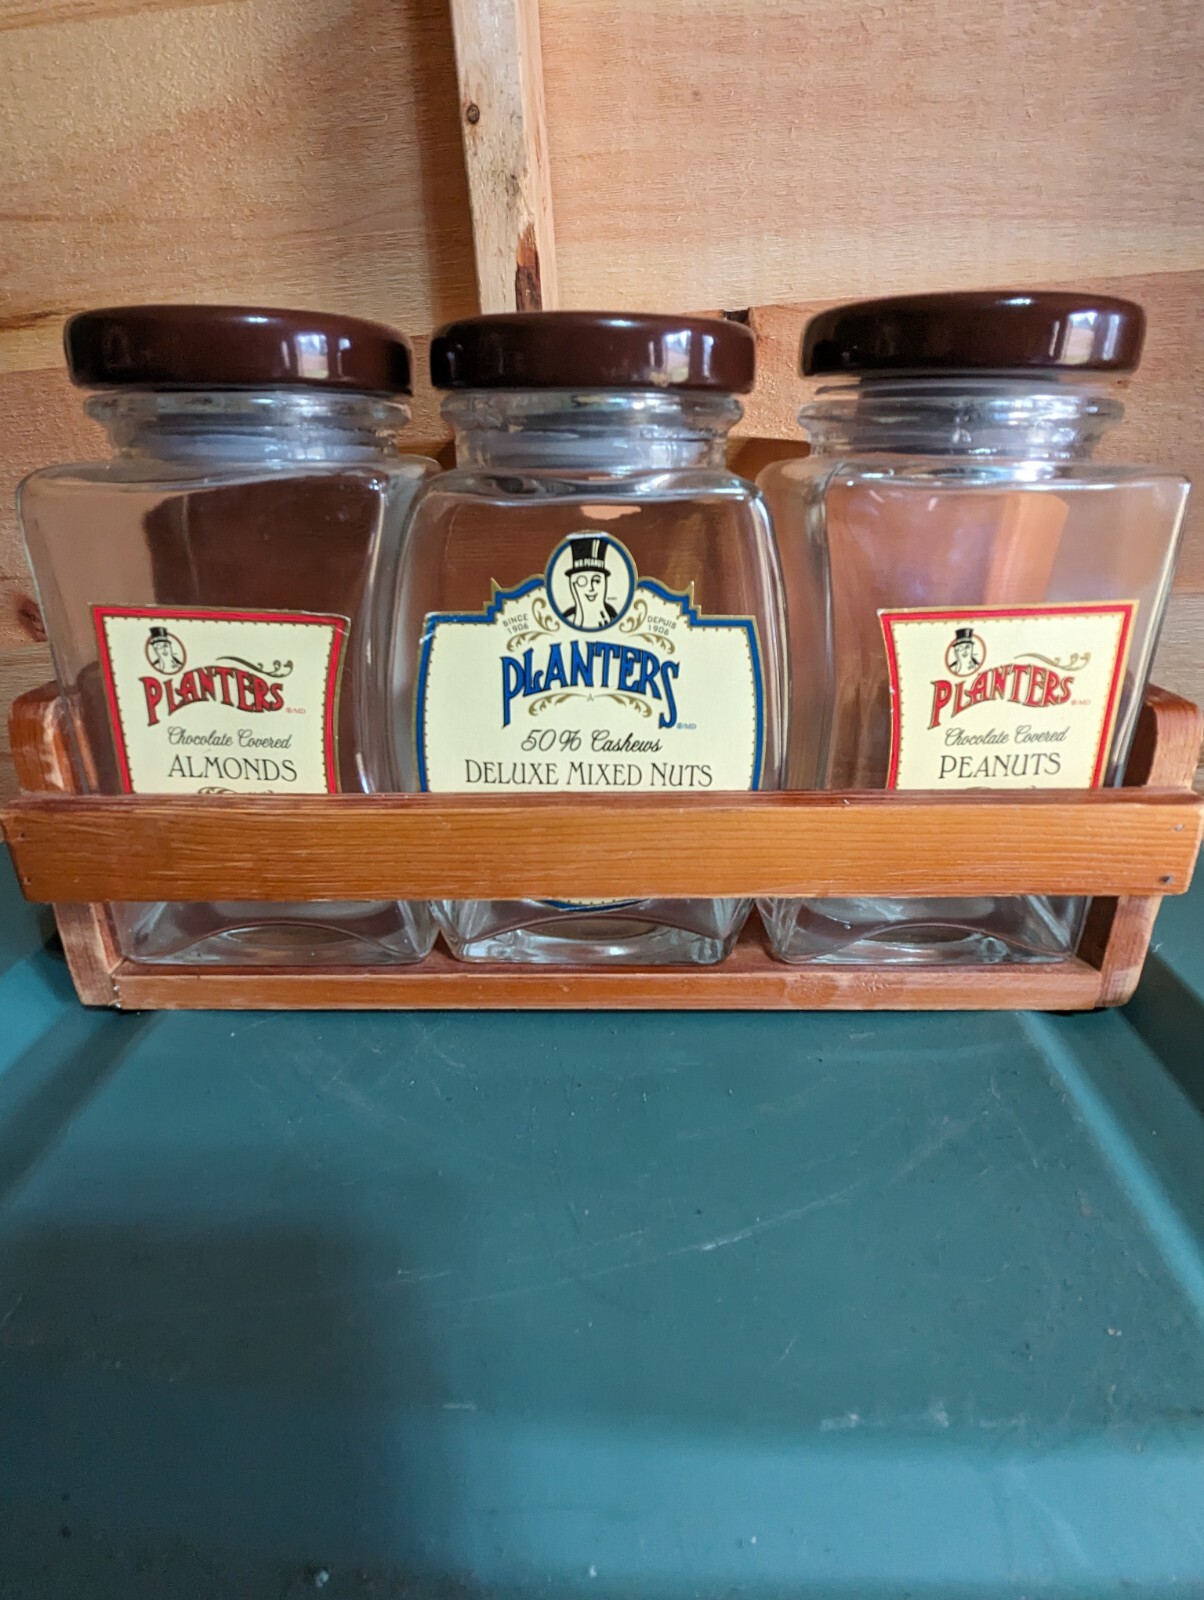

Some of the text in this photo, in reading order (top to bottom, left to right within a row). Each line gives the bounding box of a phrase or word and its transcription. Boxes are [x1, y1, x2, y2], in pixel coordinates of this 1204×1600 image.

[502, 613, 529, 627] SINCE
[507, 622, 530, 635] 1906
[647, 615, 677, 630] DEPUIS
[648, 624, 670, 636] 1906
[138, 665, 285, 727] PLANTERS
[500, 640, 680, 729] PLANTERS
[927, 663, 1075, 730] PLANTERS
[167, 726, 293, 749] Chocolate Covered
[521, 729, 663, 752] 50% Cashews
[944, 724, 1071, 747] Chocolate Covered
[167, 754, 298, 782] ALMONDS
[465, 759, 713, 787] DELUXE MIXED NUTS
[938, 752, 1062, 779] PEANUTS
